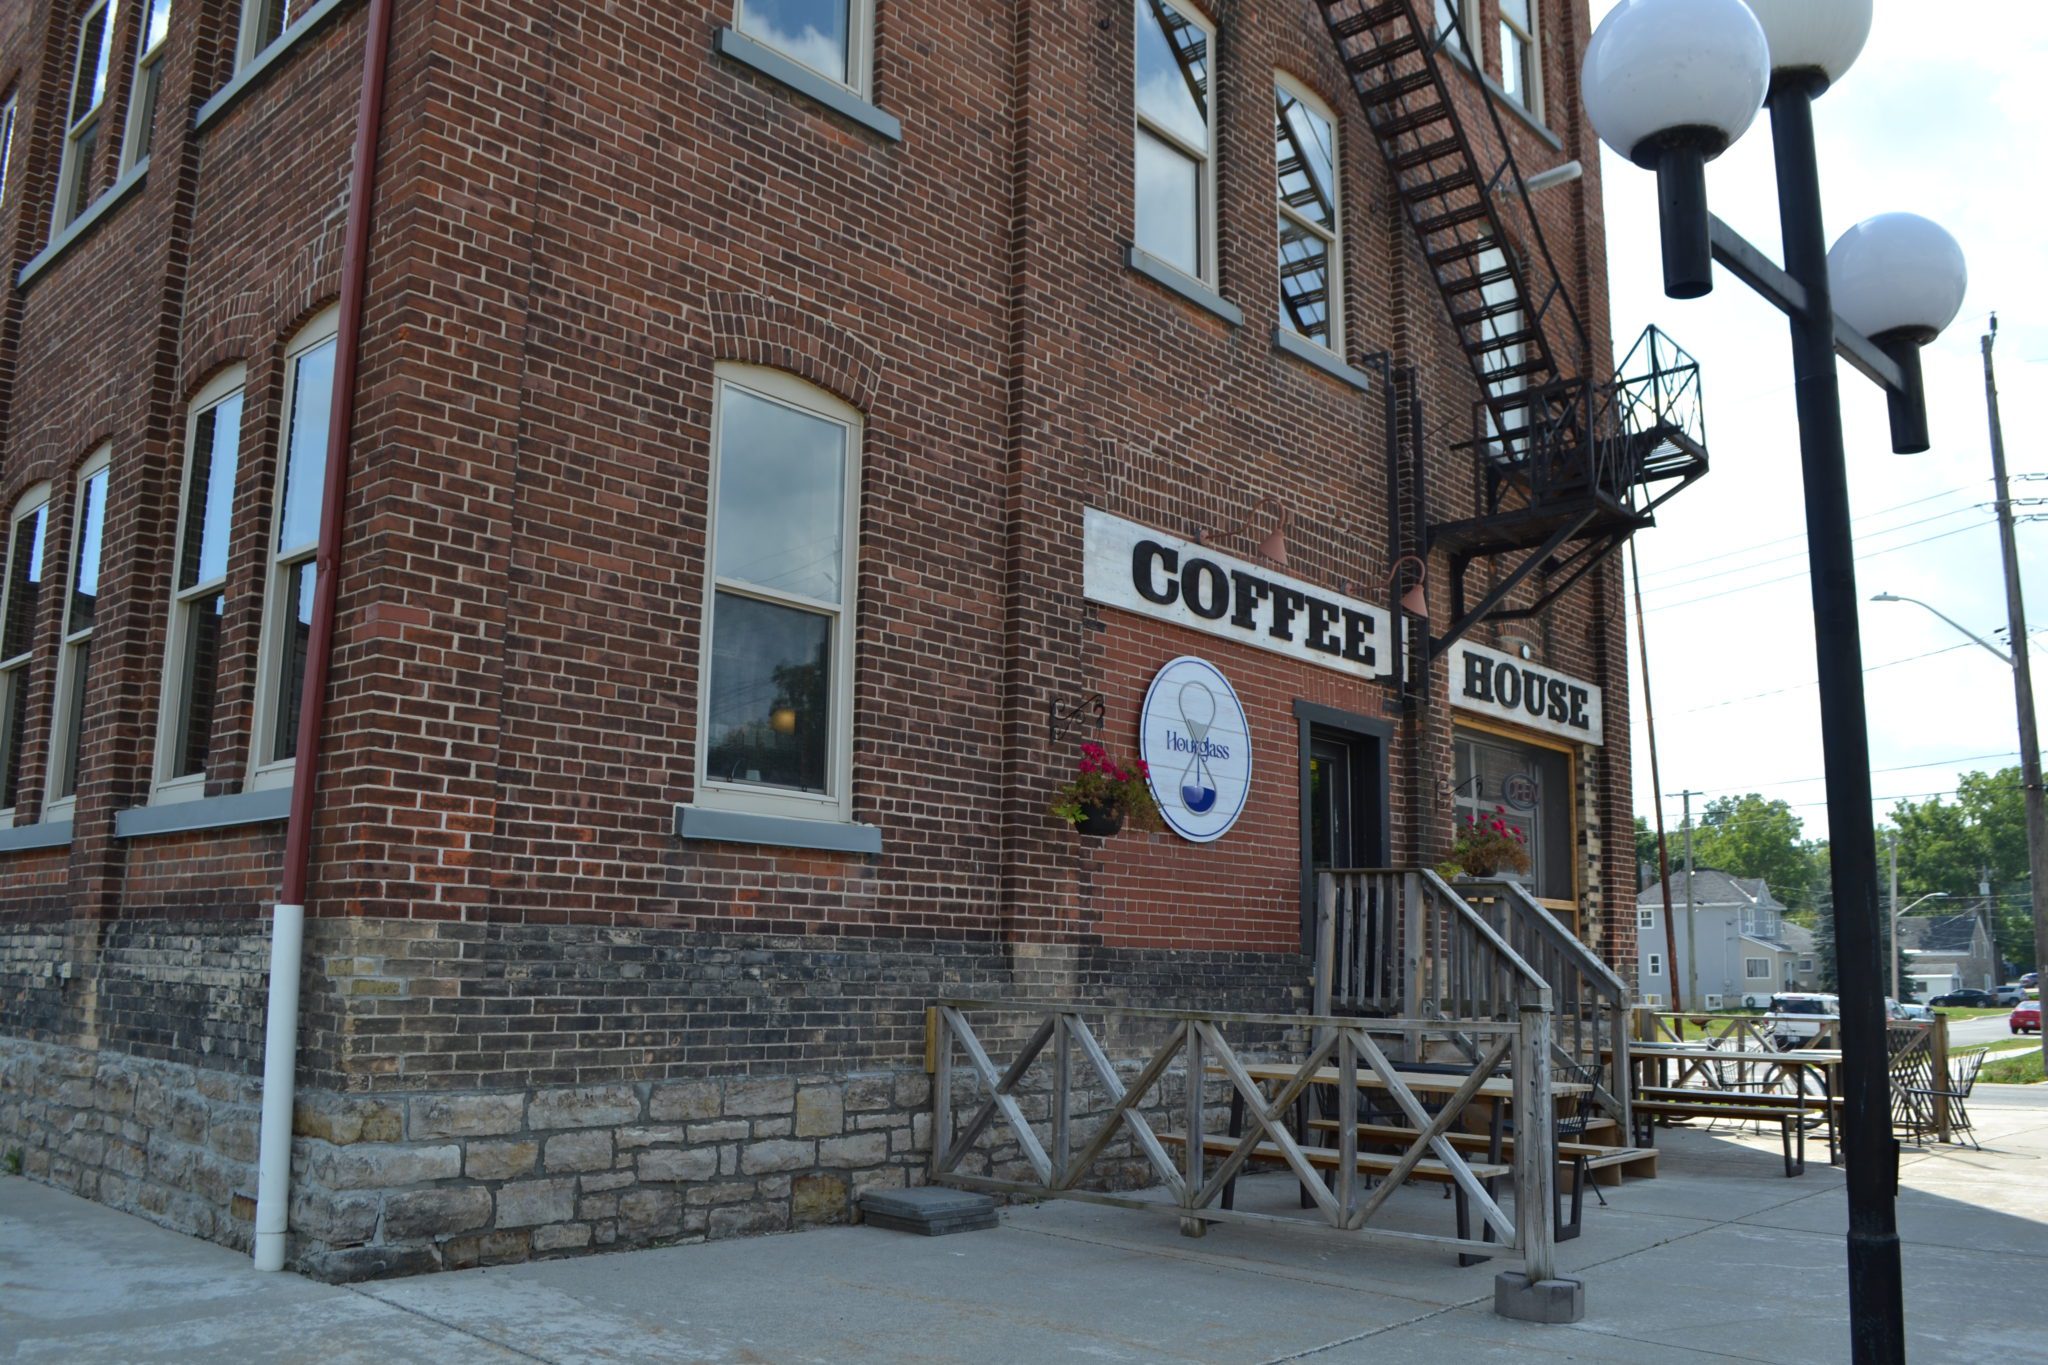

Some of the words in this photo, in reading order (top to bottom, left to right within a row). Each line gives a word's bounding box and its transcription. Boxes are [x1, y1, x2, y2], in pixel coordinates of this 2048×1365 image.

[1132, 540, 1376, 666] COFFEE
[1463, 651, 1589, 730] HOUSE
[1166, 730, 1230, 763] Hourglass
[1509, 780, 1539, 803] OPEN
